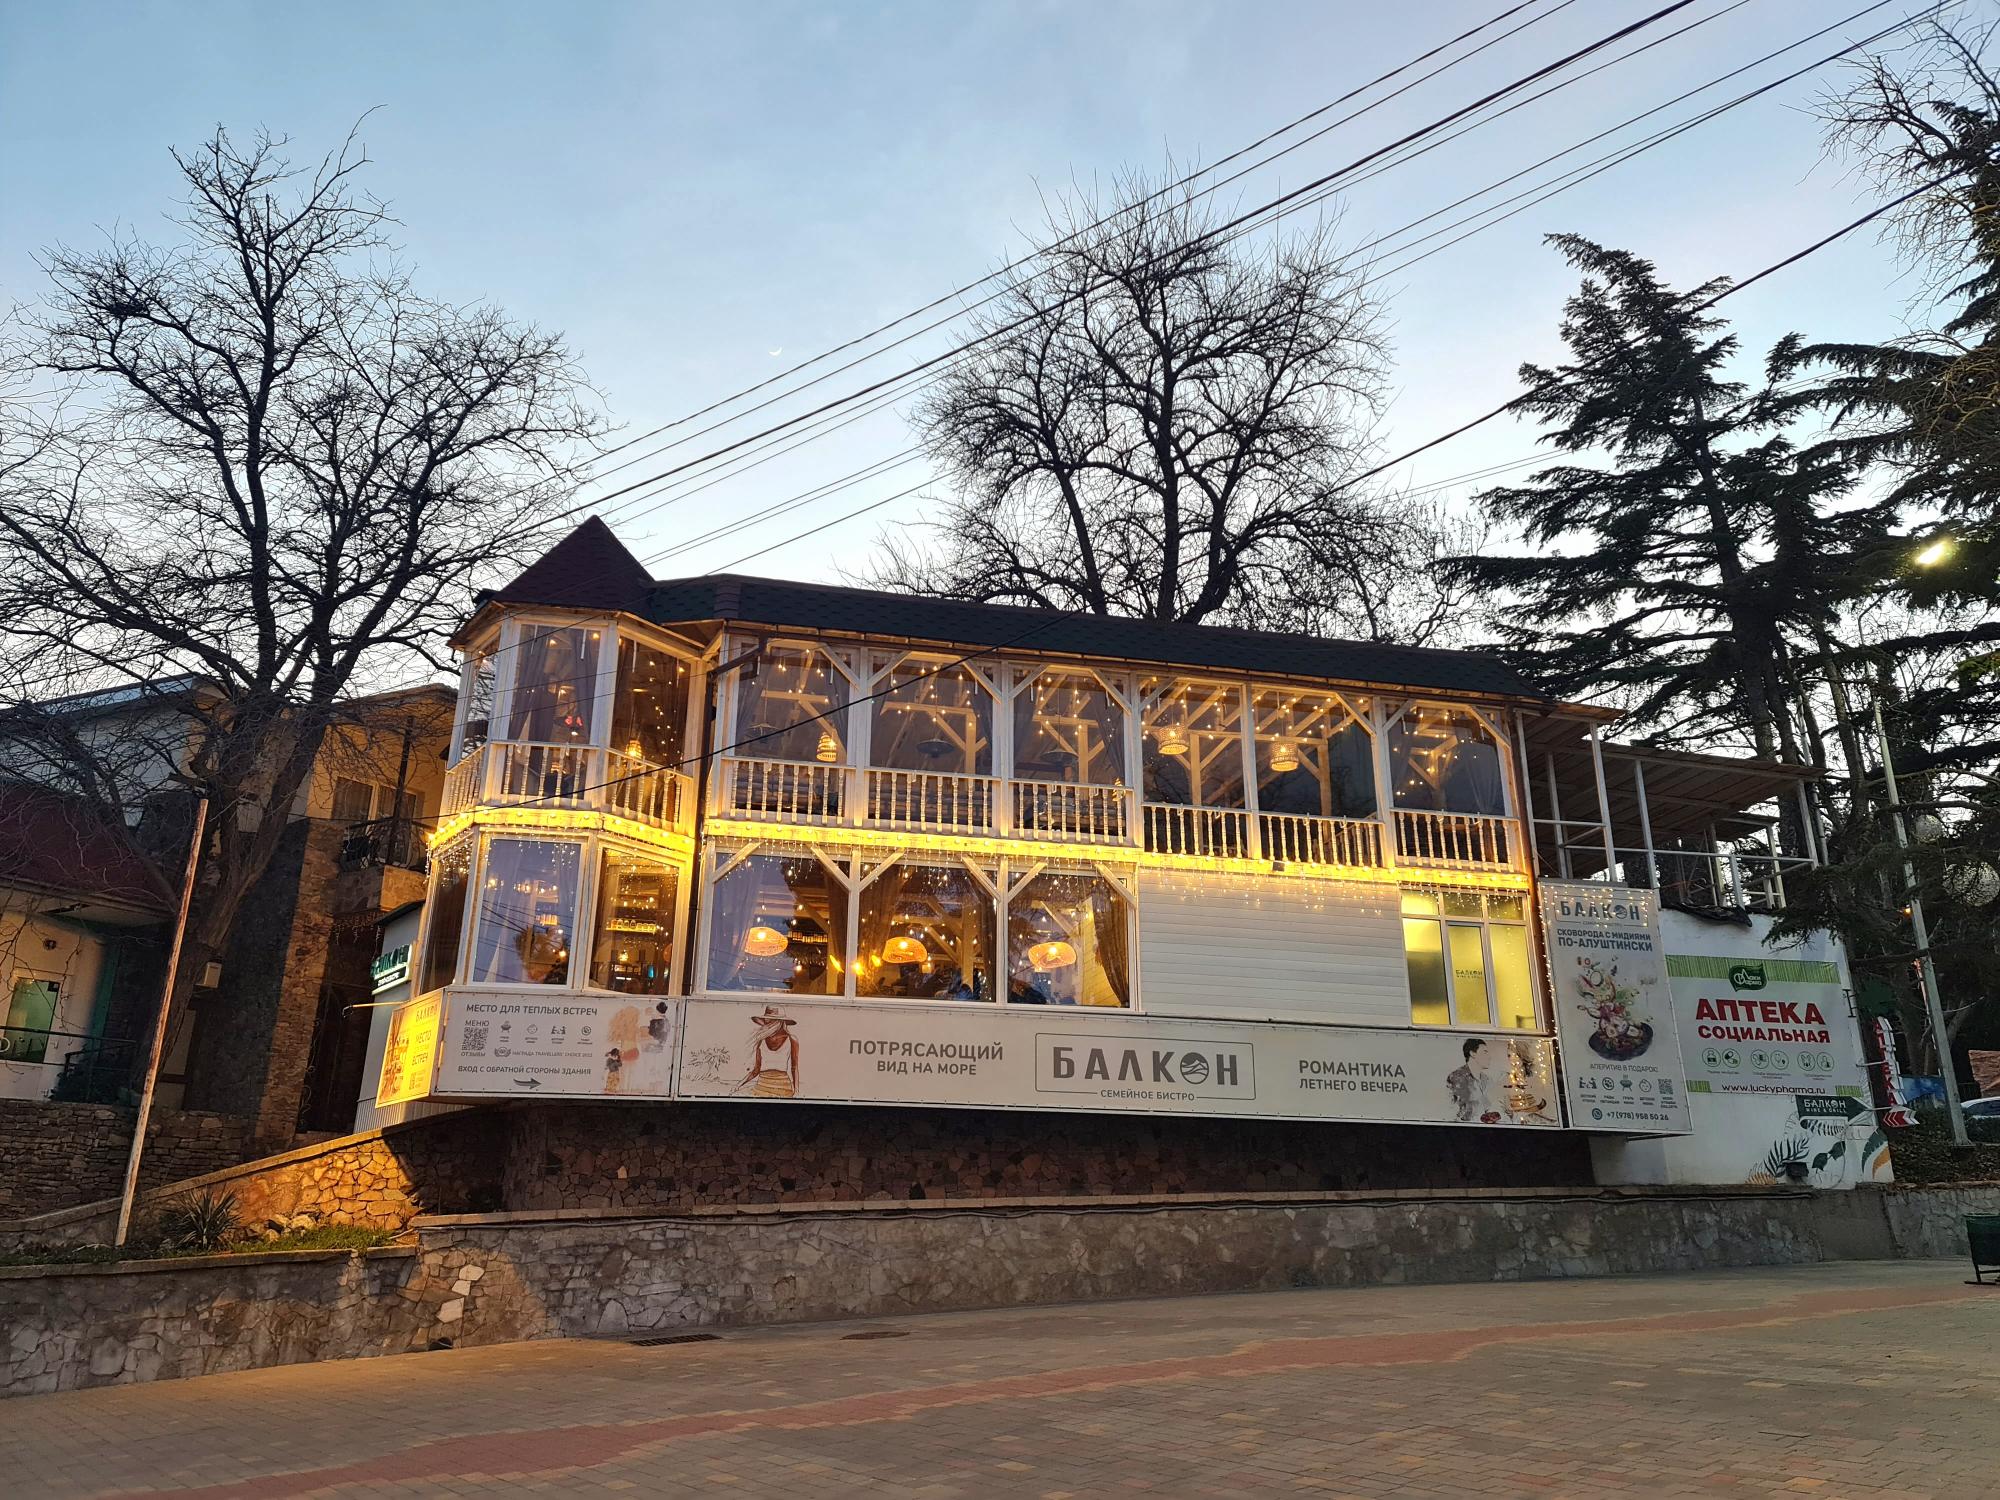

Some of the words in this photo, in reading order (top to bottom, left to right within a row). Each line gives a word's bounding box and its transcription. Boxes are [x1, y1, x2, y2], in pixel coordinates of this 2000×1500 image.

[1561, 901, 1640, 920] БАЛКОН
[1557, 929, 1604, 939] СКОВОРОДА
[1612, 932, 1651, 941] МИДИЯМИ
[1558, 937, 1653, 952] ПО-АЛУШТИНСКИ
[466, 1004, 498, 1013] МЕСТО
[500, 1005, 520, 1015] ДЛЯ
[523, 1006, 561, 1015] ТЕПЛЫХ
[563, 1007, 598, 1016] ВСТРЕЧ
[1696, 998, 1826, 1025] АПТЕКА
[1698, 1025, 1830, 1043] СОЦИАЛЬНАЯ
[849, 1040, 1004, 1061] ПОТРЯСАЮЩИЙ
[458, 1065, 478, 1073] ВХОД
[486, 1065, 524, 1074] ОБРАТНОЙ
[561, 1067, 592, 1075] ЗДАНИЯ
[877, 1060, 908, 1075] ВИД
[912, 1061, 933, 1074] НА
[938, 1063, 977, 1076] МОРЕ
[1053, 1046, 1238, 1086] БАЛКОН
[1299, 1060, 1406, 1078] РОМАНТИКА
[1590, 1063, 1622, 1071] АПЕРИТИВ
[1299, 1079, 1357, 1092] ЛЕТНЕГО
[1361, 1081, 1408, 1093] ВЕЧЕРА
[1721, 1084, 1826, 1095] www.luckypharma.ru
[1100, 1089, 1154, 1100] СЕМЕЙНОЕ
[1156, 1091, 1195, 1102] БИСТРО
[1804, 1099, 1846, 1109] БАЛКОН
[1616, 1111, 1634, 1120] (978)
